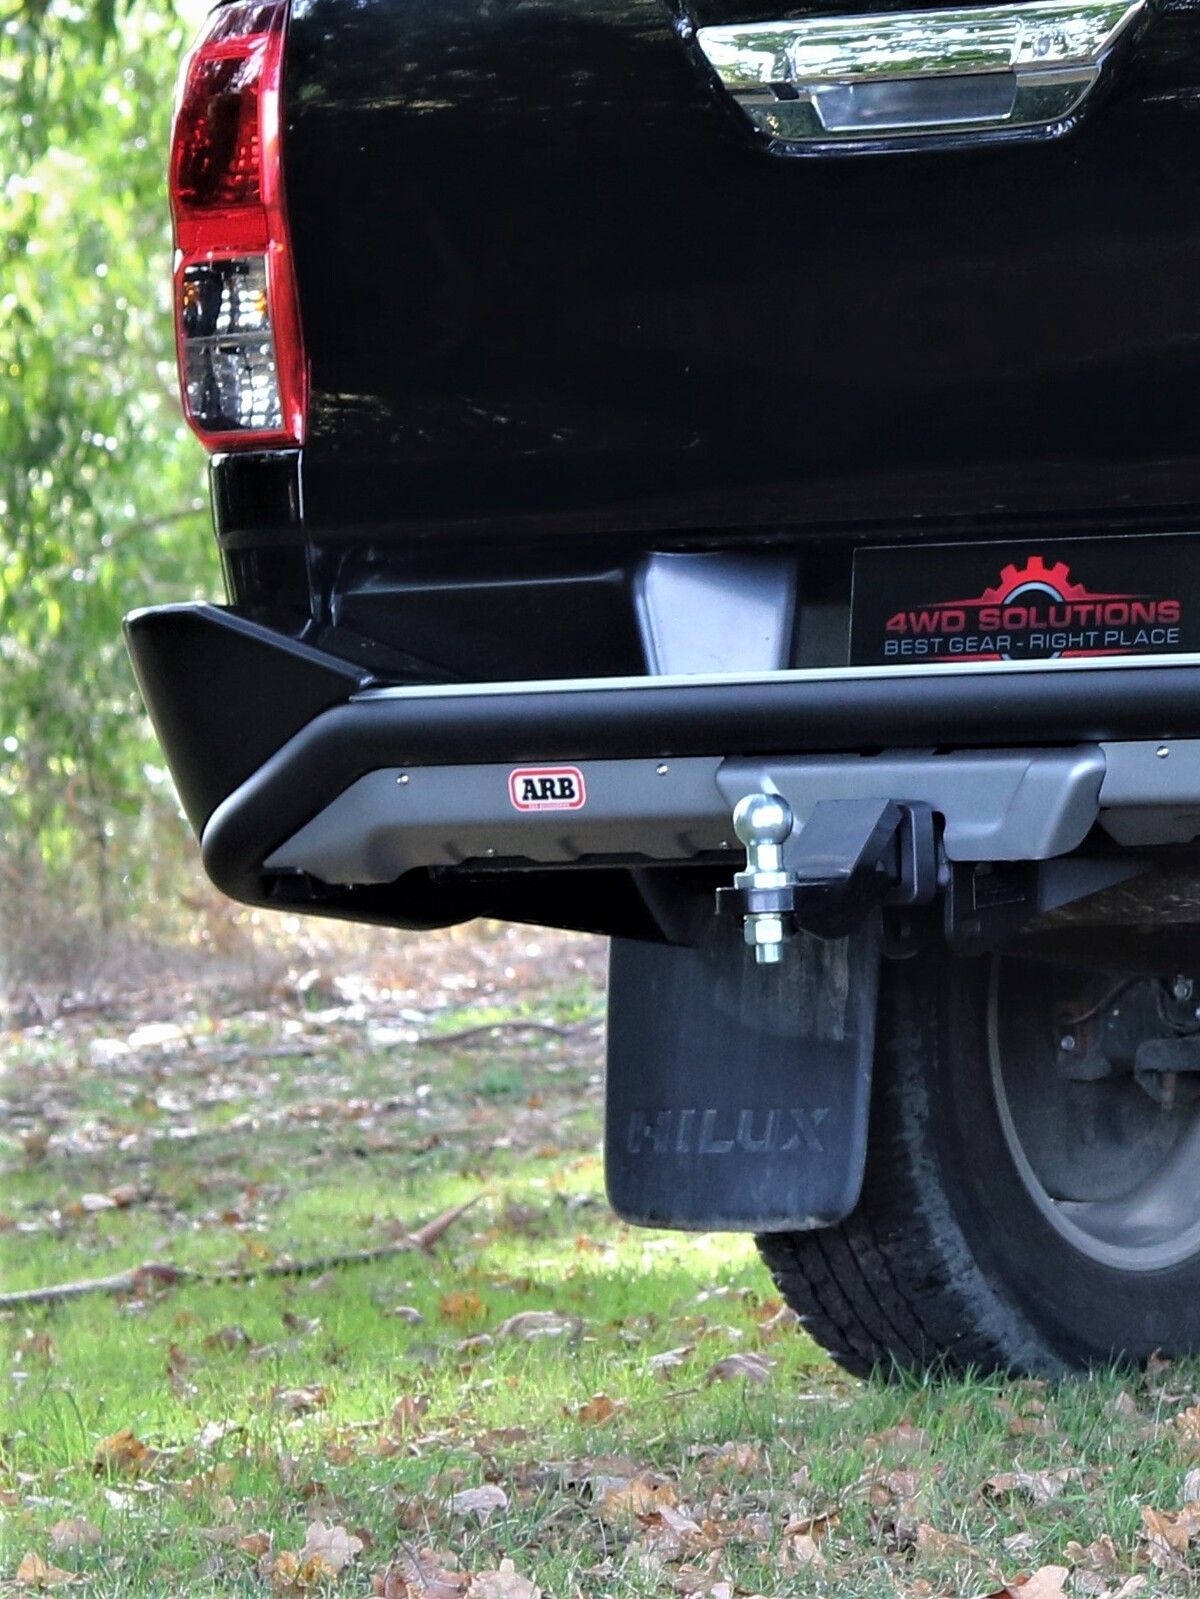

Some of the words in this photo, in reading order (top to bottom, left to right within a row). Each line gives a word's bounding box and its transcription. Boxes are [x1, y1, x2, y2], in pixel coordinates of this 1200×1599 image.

[885, 610, 966, 634] 4WD
[978, 600, 1181, 631] SOLUTIONS
[884, 638, 944, 656] BEST
[949, 634, 1011, 653] GEAR
[1030, 630, 1099, 649] RIGHT
[1104, 628, 1180, 645] PLACE
[522, 777, 576, 801] ARB
[627, 1107, 830, 1154] HILUX
